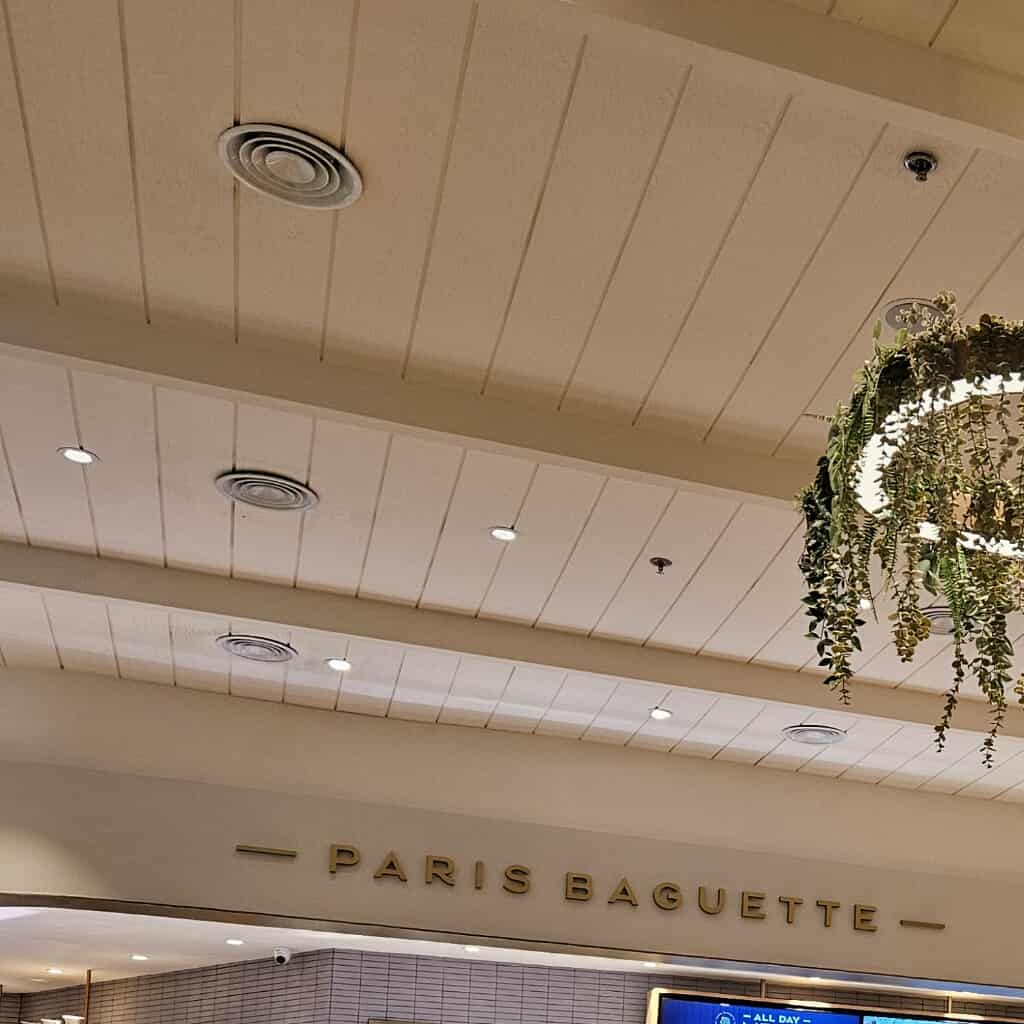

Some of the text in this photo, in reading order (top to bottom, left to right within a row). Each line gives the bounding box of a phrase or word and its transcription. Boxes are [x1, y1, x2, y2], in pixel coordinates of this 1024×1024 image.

[328, 843, 879, 932] PARIS BAGUETTE
[753, 1013, 801, 1024] ALL DAY
